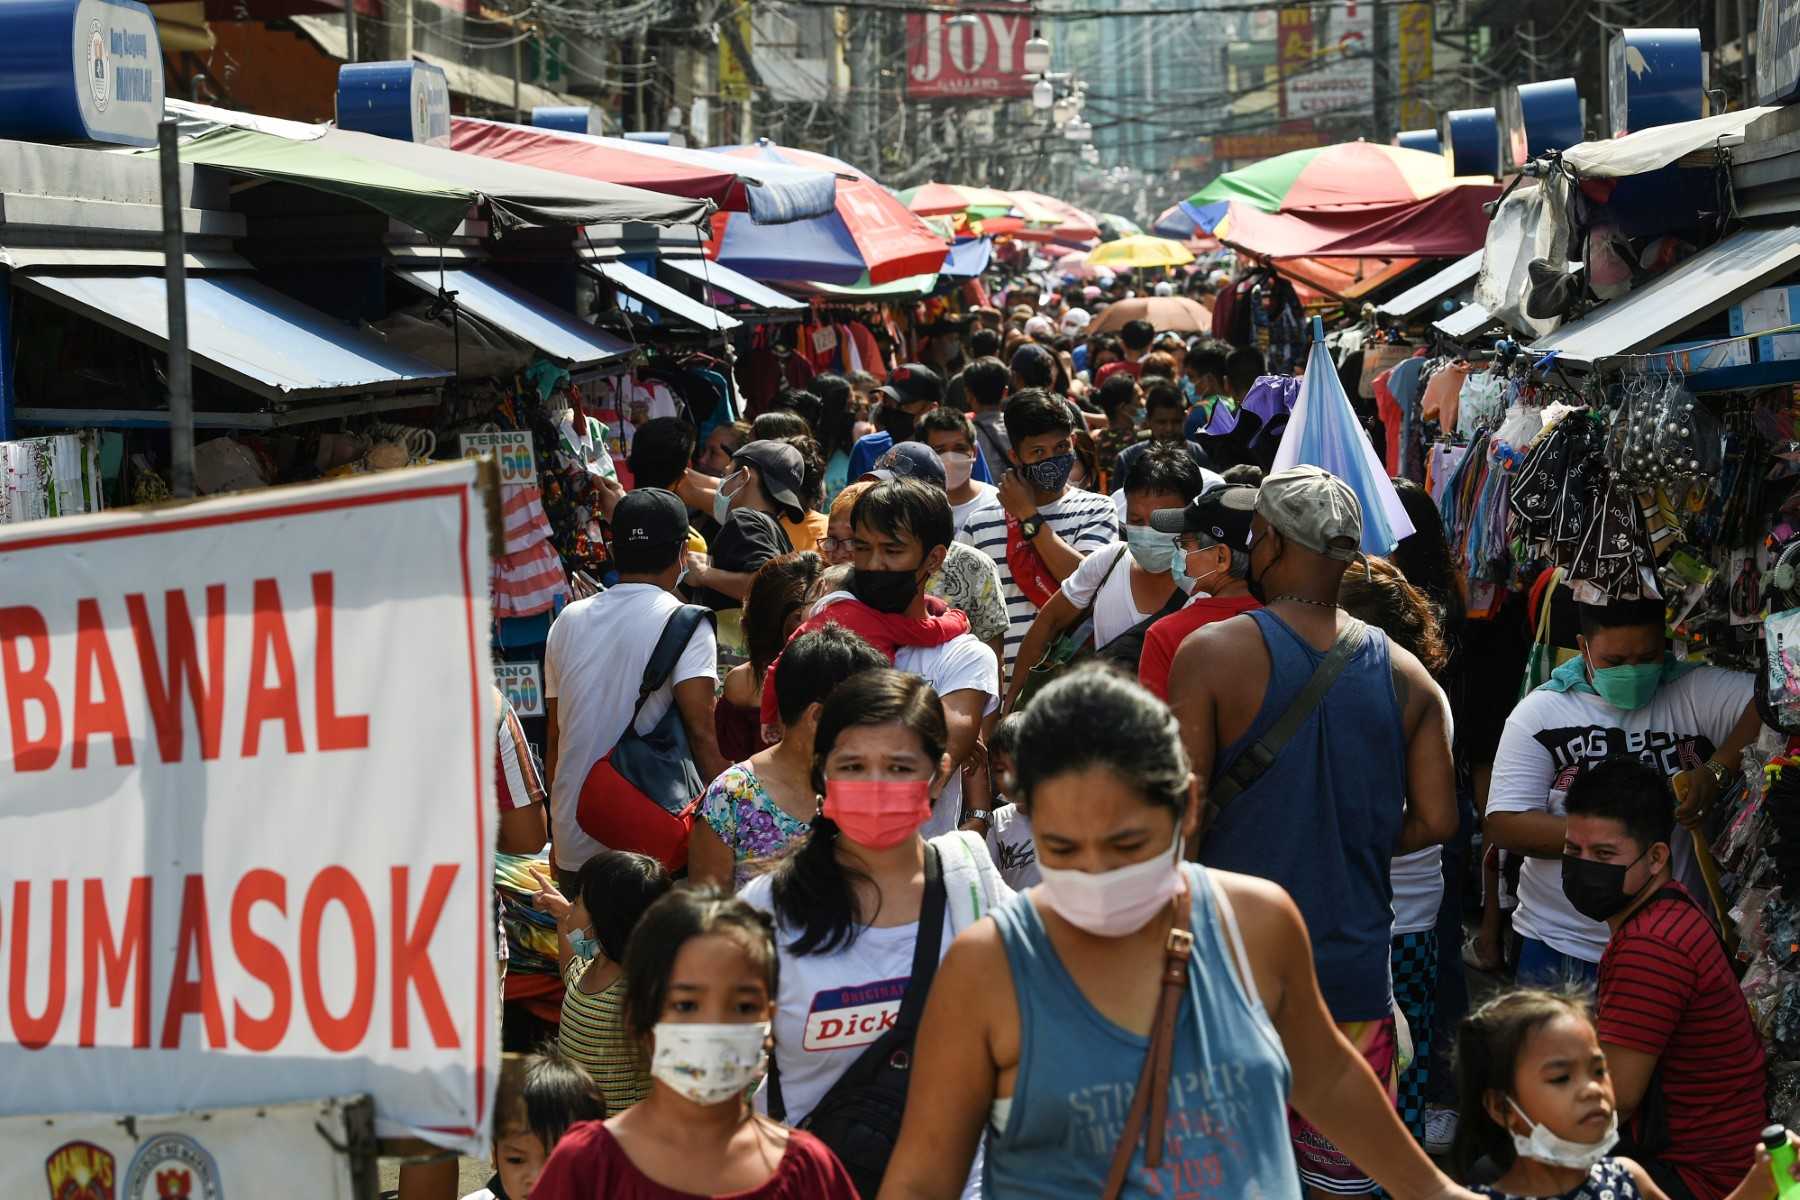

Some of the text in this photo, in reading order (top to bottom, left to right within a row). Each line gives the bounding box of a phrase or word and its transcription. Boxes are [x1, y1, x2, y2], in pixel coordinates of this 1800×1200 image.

[911, 11, 1021, 81] JOY
[465, 433, 525, 446] TERNO
[1609, 506, 1632, 527] Dior
[0, 571, 371, 774] BAWAL
[494, 666, 532, 677] RNO
[0, 864, 462, 1052] UMASOK
